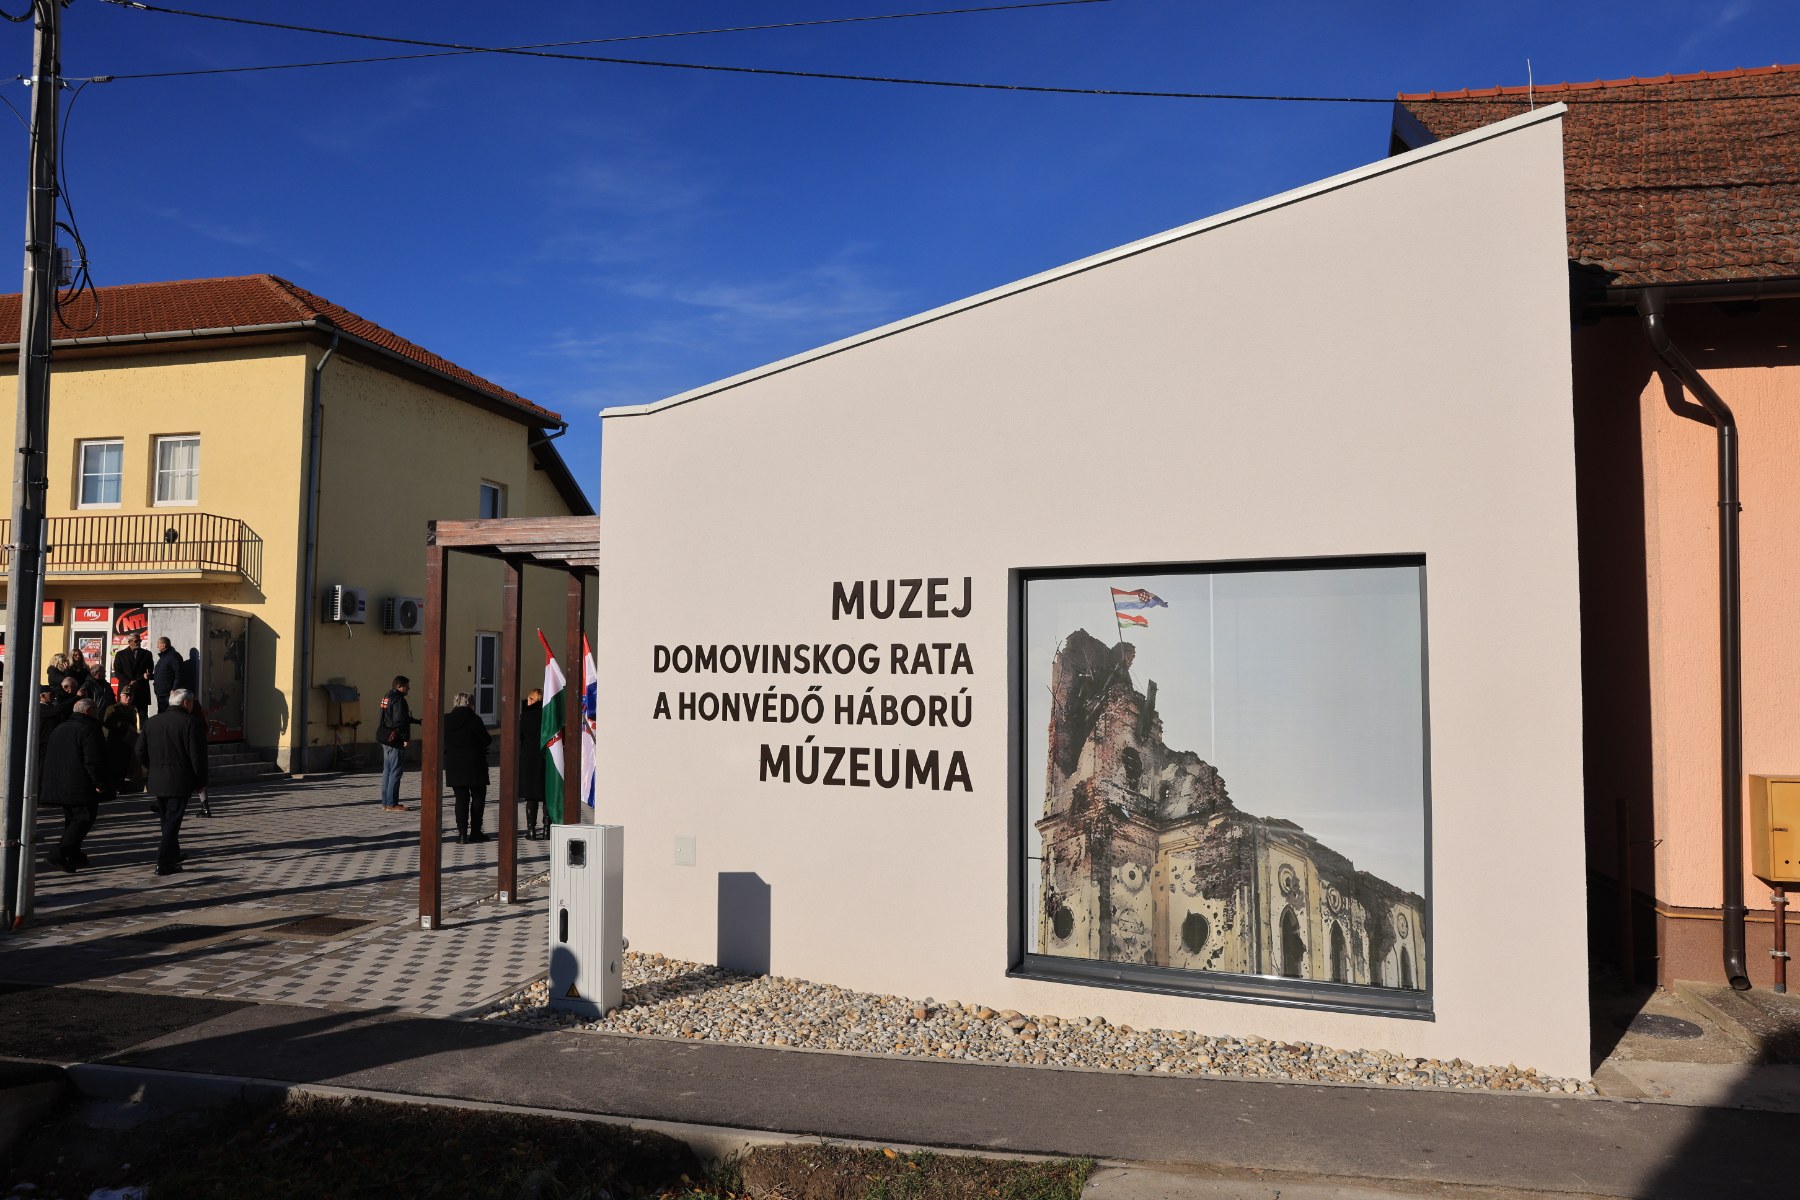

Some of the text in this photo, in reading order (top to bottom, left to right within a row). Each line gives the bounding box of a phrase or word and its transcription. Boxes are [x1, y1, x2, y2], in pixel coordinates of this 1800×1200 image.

[832, 577, 971, 620] MUZEJ
[654, 643, 974, 674] DOMOVINSKOG RATA
[653, 686, 971, 727] A HONVÉDŐ HÁBORÚ
[760, 735, 973, 792] MÚZEUMA
